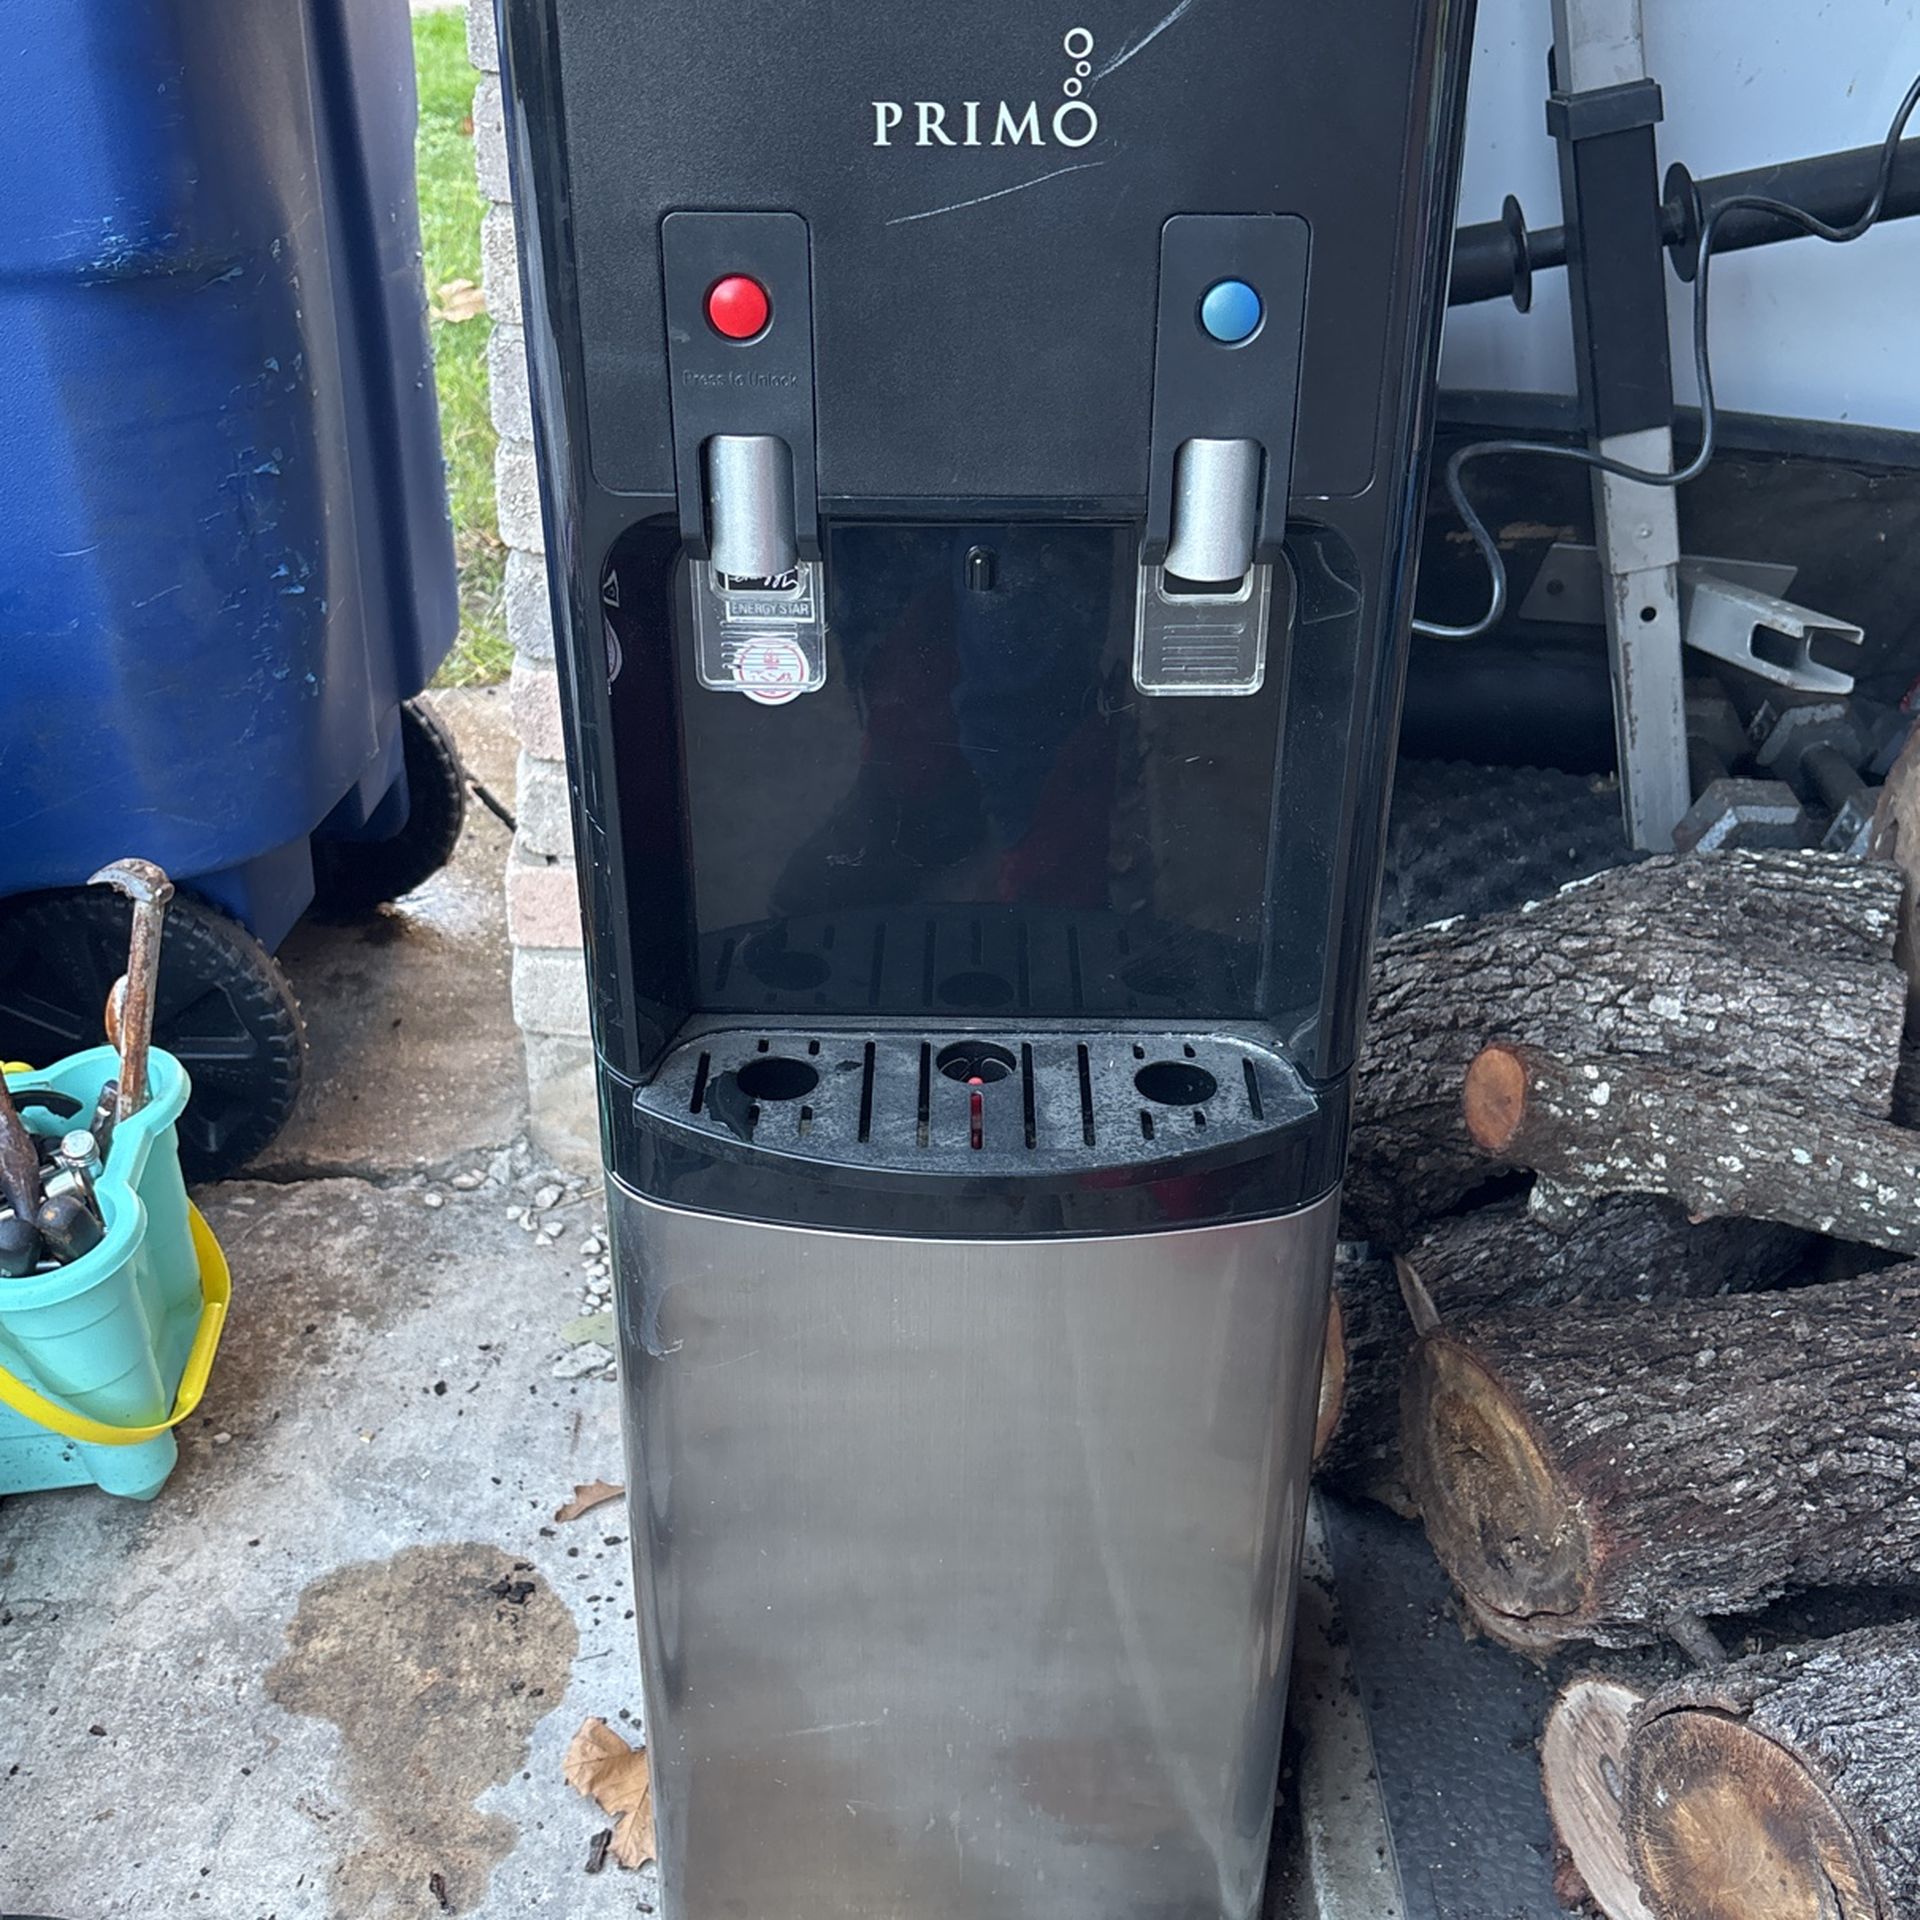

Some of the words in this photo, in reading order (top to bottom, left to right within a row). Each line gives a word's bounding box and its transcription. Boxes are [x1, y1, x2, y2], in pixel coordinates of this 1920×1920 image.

[871, 100, 1099, 147] PRIMO
[682, 368, 725, 387] Press
[728, 370, 745, 387] to
[748, 370, 798, 388] Unlock
[732, 602, 778, 615] ENERGY
[779, 603, 810, 616] STAR
